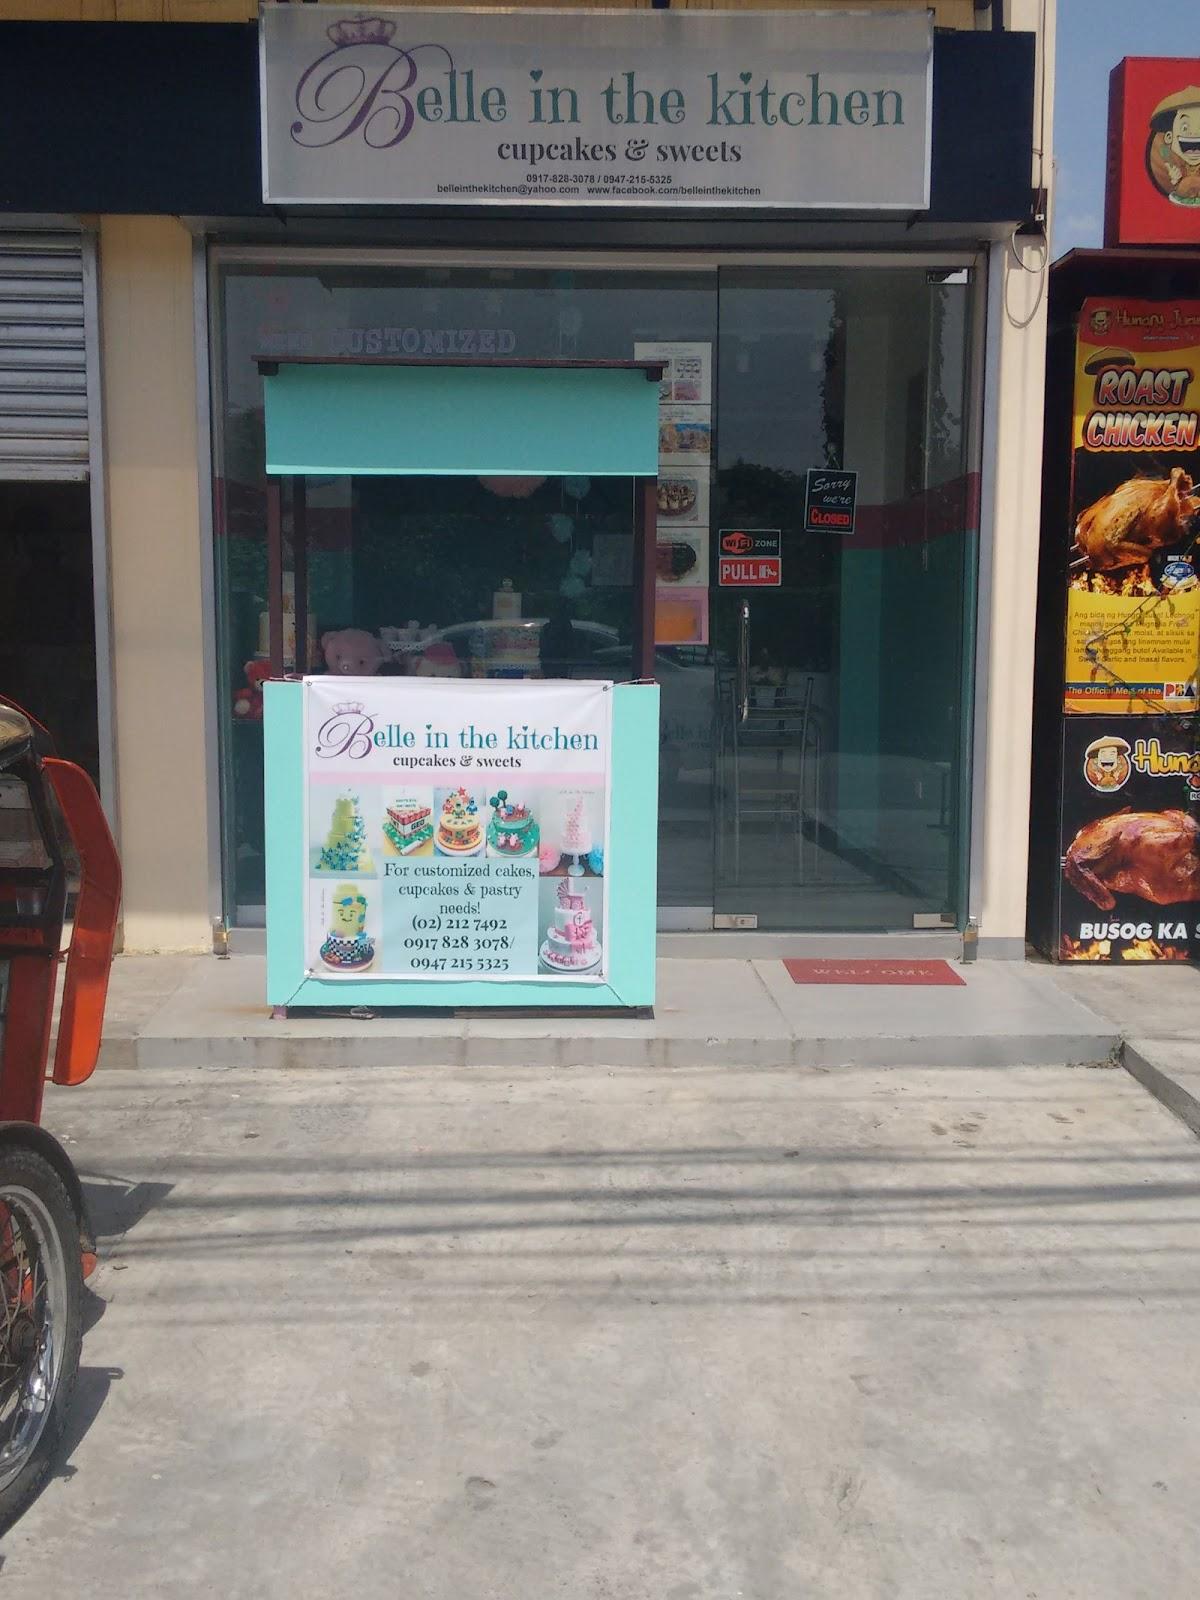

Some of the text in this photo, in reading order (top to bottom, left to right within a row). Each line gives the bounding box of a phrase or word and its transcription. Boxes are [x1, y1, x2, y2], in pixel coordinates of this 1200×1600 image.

[290, 43, 905, 149] Belle in the kitchen
[497, 137, 742, 165] cupcakes & sweets
[526, 174, 595, 183] 0917-828-3078
[603, 174, 672, 184] 0947-215-5325
[437, 184, 761, 195] belleinthekitchen@yahoo.com www.facebook.com/belleinthekitchen
[1099, 370, 1189, 404] ROAST
[1087, 412, 1198, 446] CHICKEN
[812, 477, 851, 493] Sorry
[755, 540, 778, 548] ZONE
[722, 564, 757, 580] PULL
[1067, 686, 1080, 694] The
[1148, 686, 1162, 694] the
[315, 712, 598, 759] Belle in the kitchen
[393, 753, 522, 768] cupcakes & sweets
[384, 863, 536, 879] For customized cakes,
[398, 883, 522, 899] cupcakes & pastry
[440, 901, 481, 915] needs!
[412, 915, 508, 932] (02) 212 7492
[1080, 922, 1153, 940] BUSOG
[1157, 922, 1188, 940] KA
[404, 935, 516, 951] 0917 828 3078/
[410, 957, 509, 970] 0947 215 5325
